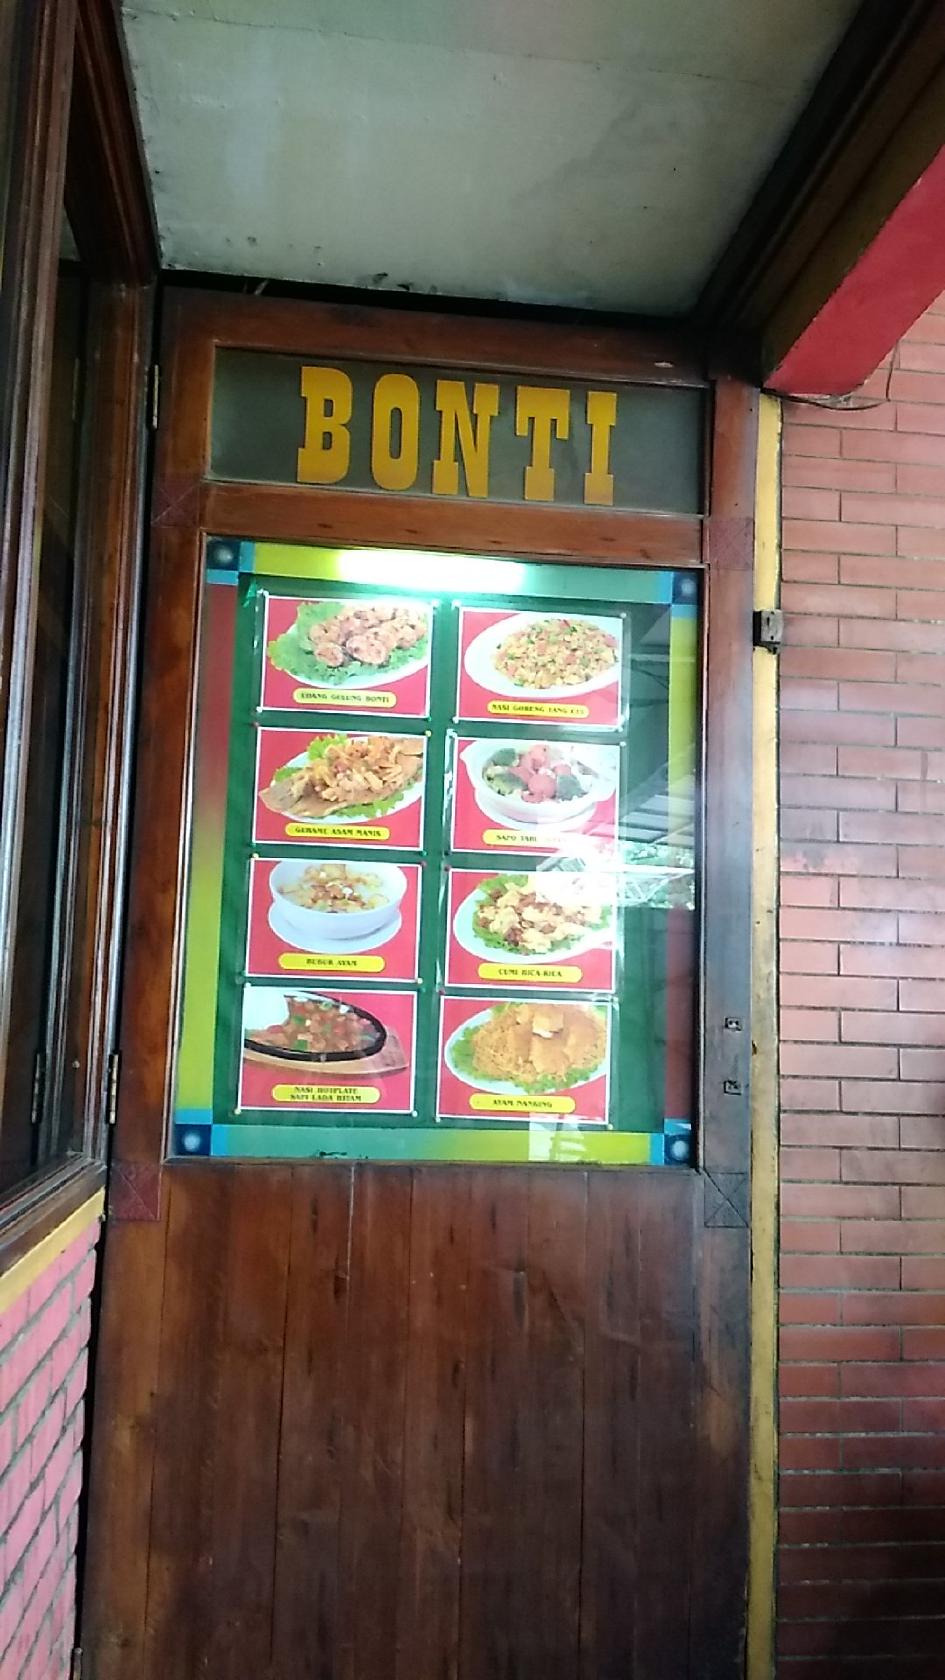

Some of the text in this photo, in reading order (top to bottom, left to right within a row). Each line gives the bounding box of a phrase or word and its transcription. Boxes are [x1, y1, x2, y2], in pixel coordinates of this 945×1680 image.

[297, 366, 617, 505] BONTI
[492, 703, 510, 711] NASI
[512, 704, 545, 712] GORENG
[294, 1086, 314, 1094] NASI
